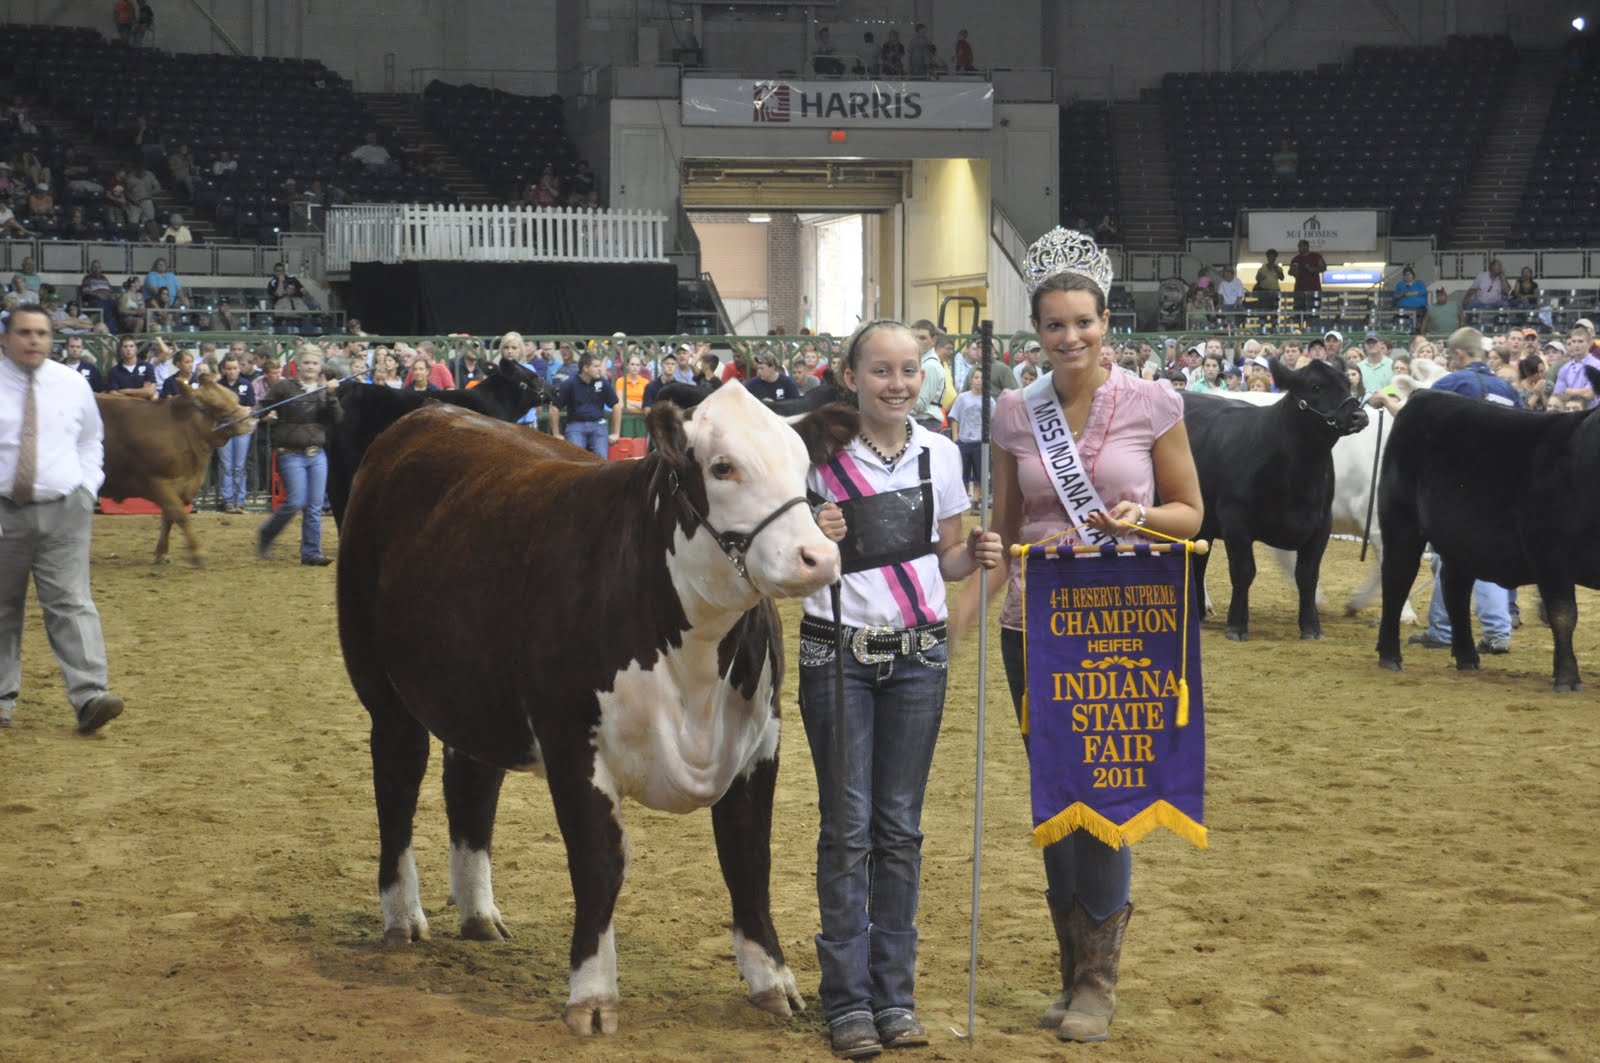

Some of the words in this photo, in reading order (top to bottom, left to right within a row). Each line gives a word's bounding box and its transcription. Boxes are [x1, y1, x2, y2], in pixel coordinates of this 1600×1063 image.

[800, 91, 922, 120] HARRIS
[1303, 230, 1338, 239] HOMES
[1032, 400, 1065, 442] MISS
[1046, 441, 1094, 511] INDIANA
[1050, 588, 1069, 609] 4-H
[1072, 586, 1122, 609] RESERVE
[1125, 584, 1177, 607] SUPREME
[1050, 608, 1178, 636] CHAMPION
[1087, 638, 1143, 653] HEIFER
[1052, 669, 1180, 701] INDIANA
[1071, 701, 1165, 733] STATE
[1083, 734, 1155, 764] FAIR
[1092, 767, 1147, 789] 2011
